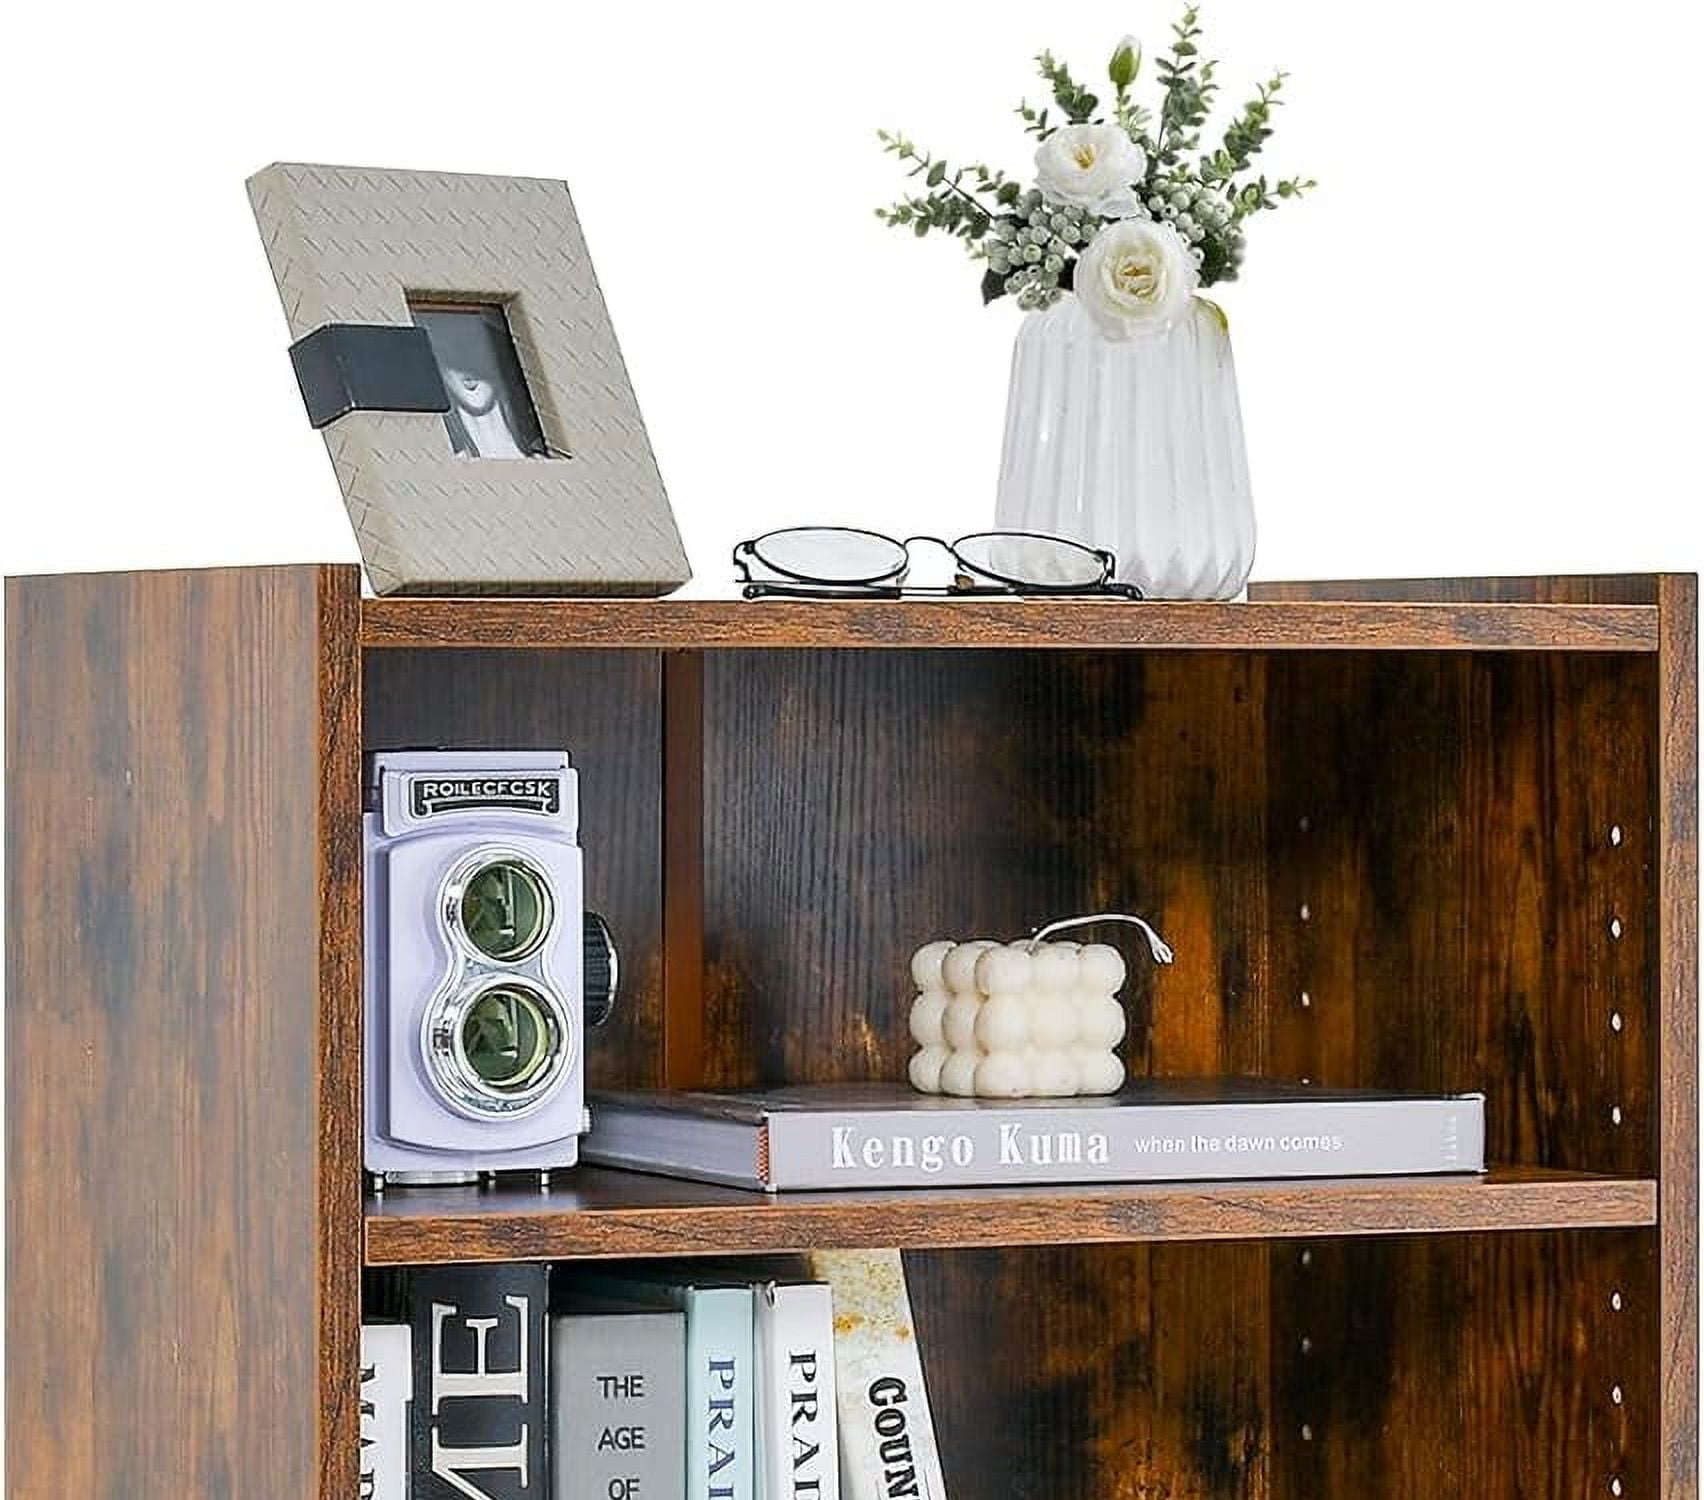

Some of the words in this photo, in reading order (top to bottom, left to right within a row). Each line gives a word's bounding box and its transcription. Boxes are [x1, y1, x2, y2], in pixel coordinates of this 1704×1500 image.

[832, 1126, 974, 1172] Kengo
[1000, 1122, 1109, 1165] Kuma
[1134, 1134, 1185, 1153] when
[1191, 1134, 1221, 1153] the
[1224, 1133, 1275, 1152] dawn
[1279, 1133, 1344, 1152] comes
[597, 1376, 644, 1399] THE
[597, 1426, 645, 1451] AGE
